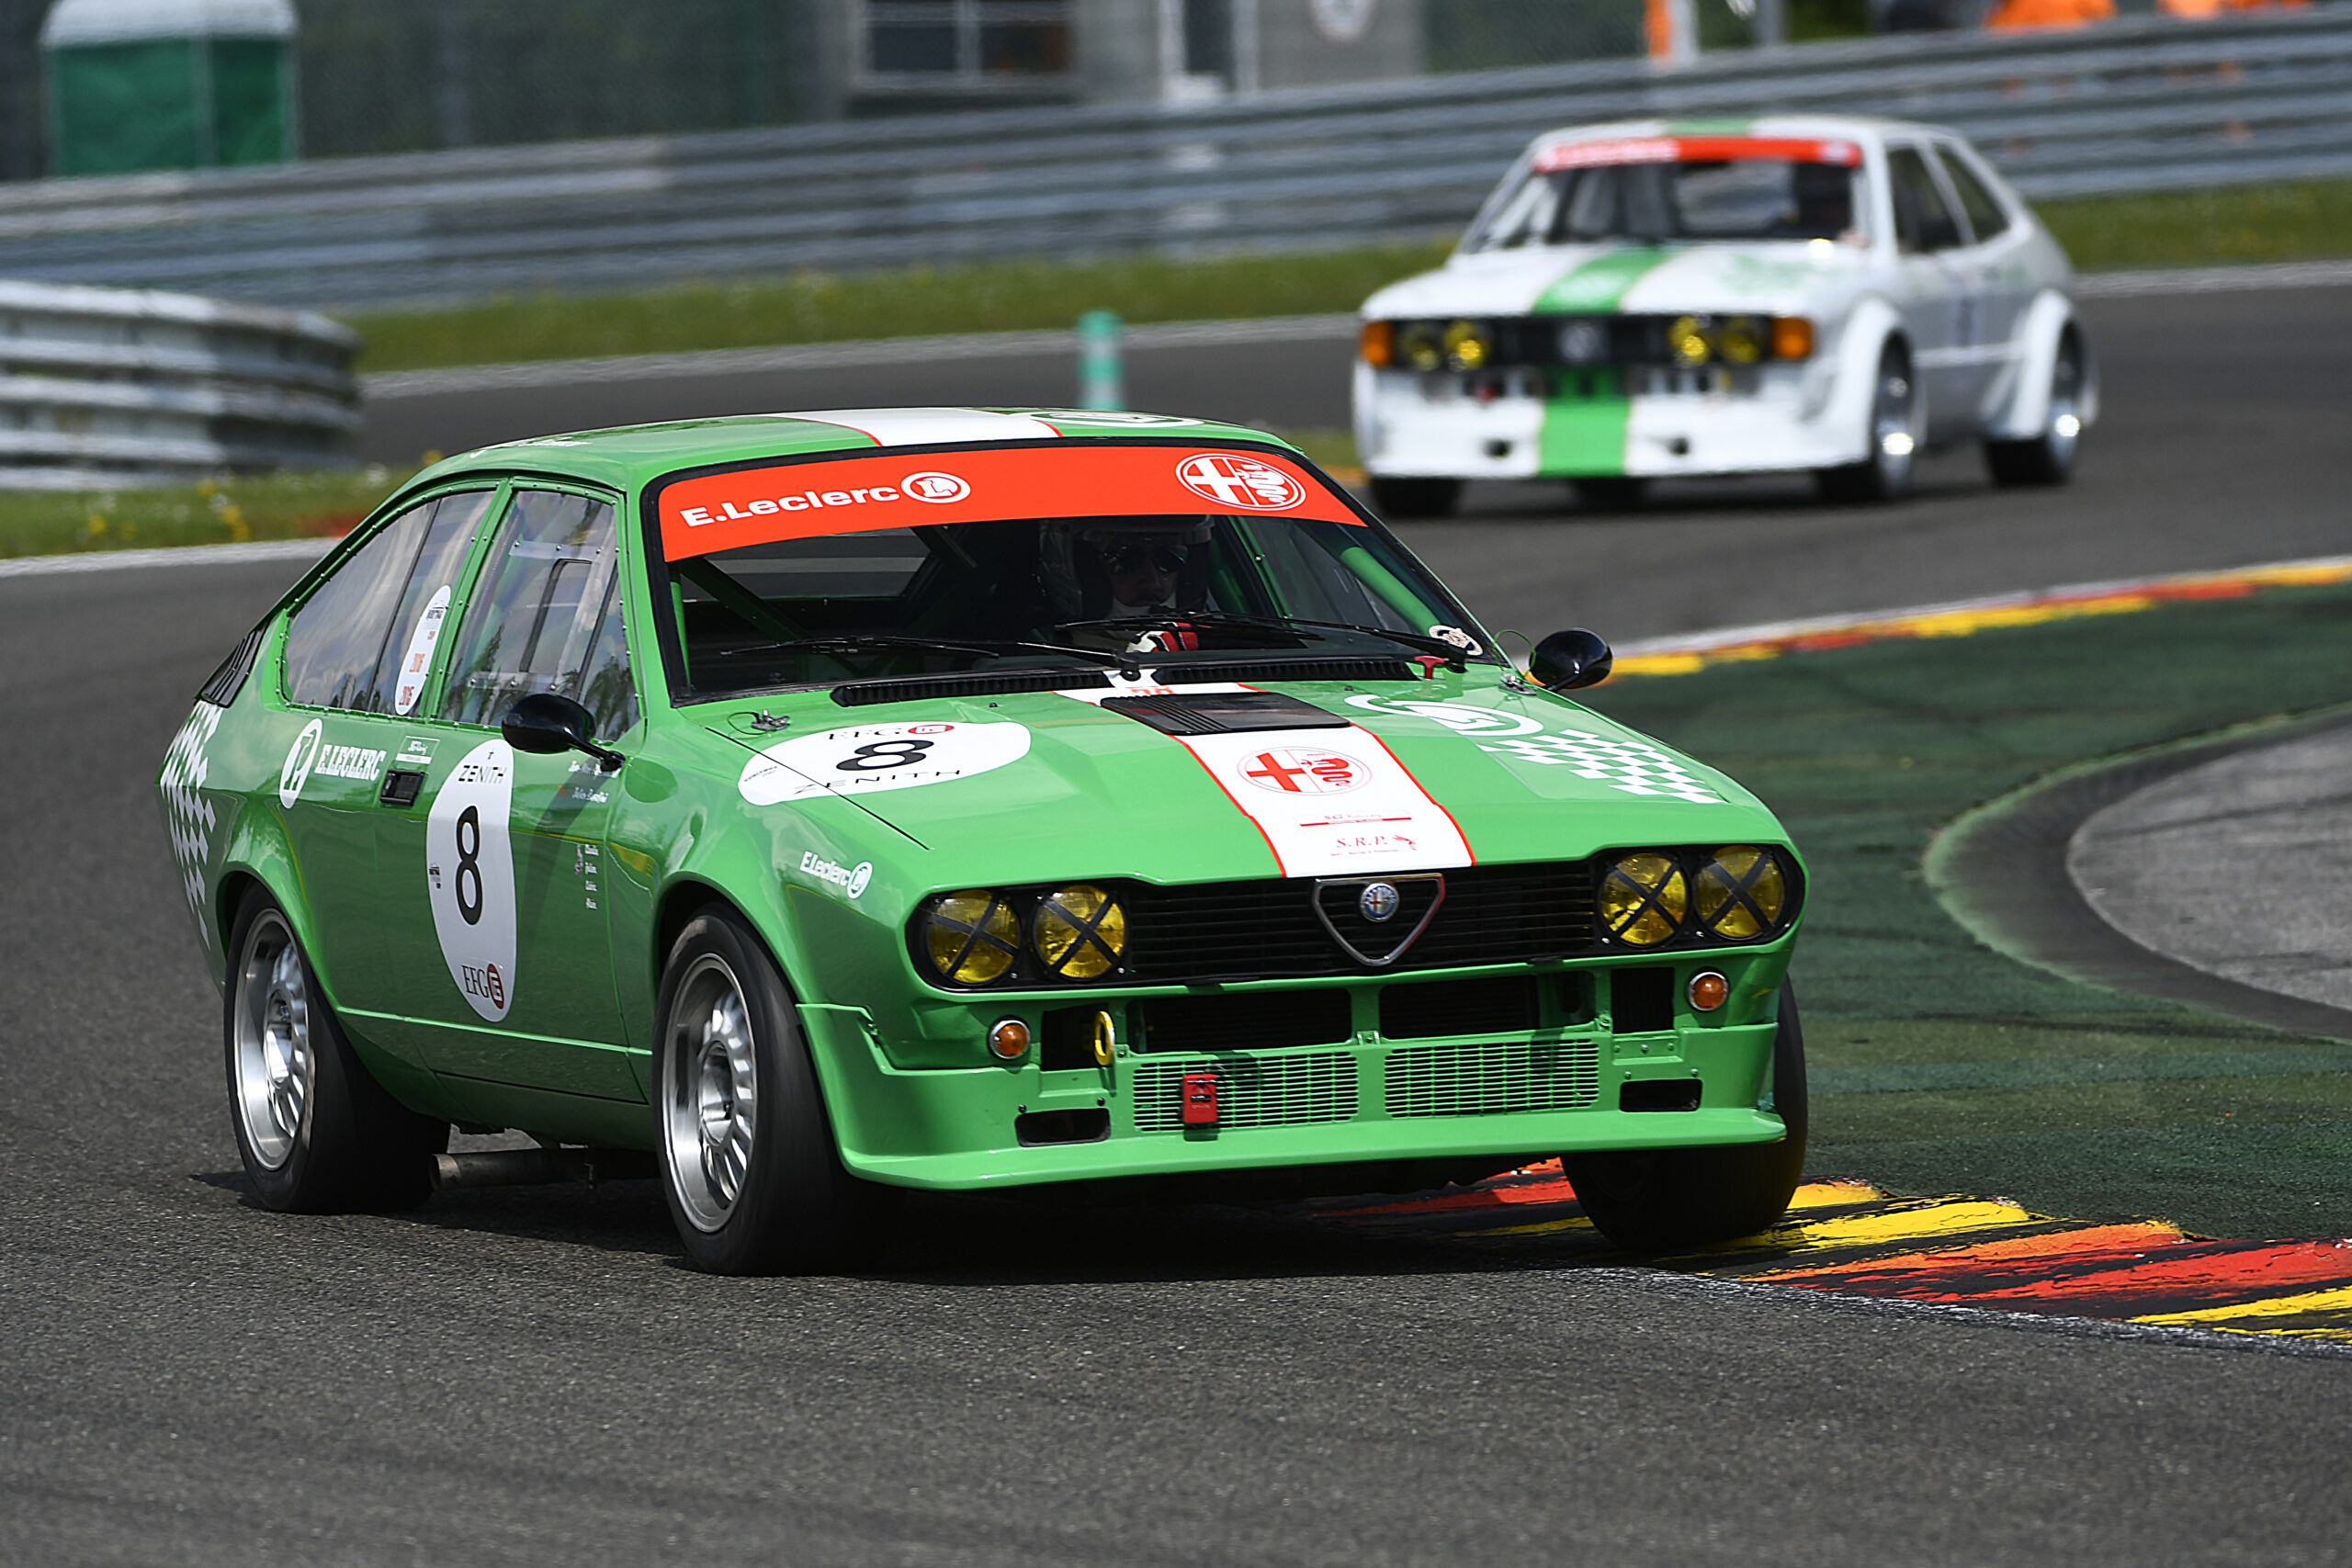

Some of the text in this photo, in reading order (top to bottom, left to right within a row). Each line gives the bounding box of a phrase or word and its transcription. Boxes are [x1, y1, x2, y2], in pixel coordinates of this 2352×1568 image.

[680, 486, 900, 527] E.Leclerc
[836, 739, 934, 771] 8
[458, 765, 507, 784] ZENITH
[794, 770, 960, 795] ZENITH
[456, 805, 482, 926] 8
[461, 964, 490, 998] EFG
